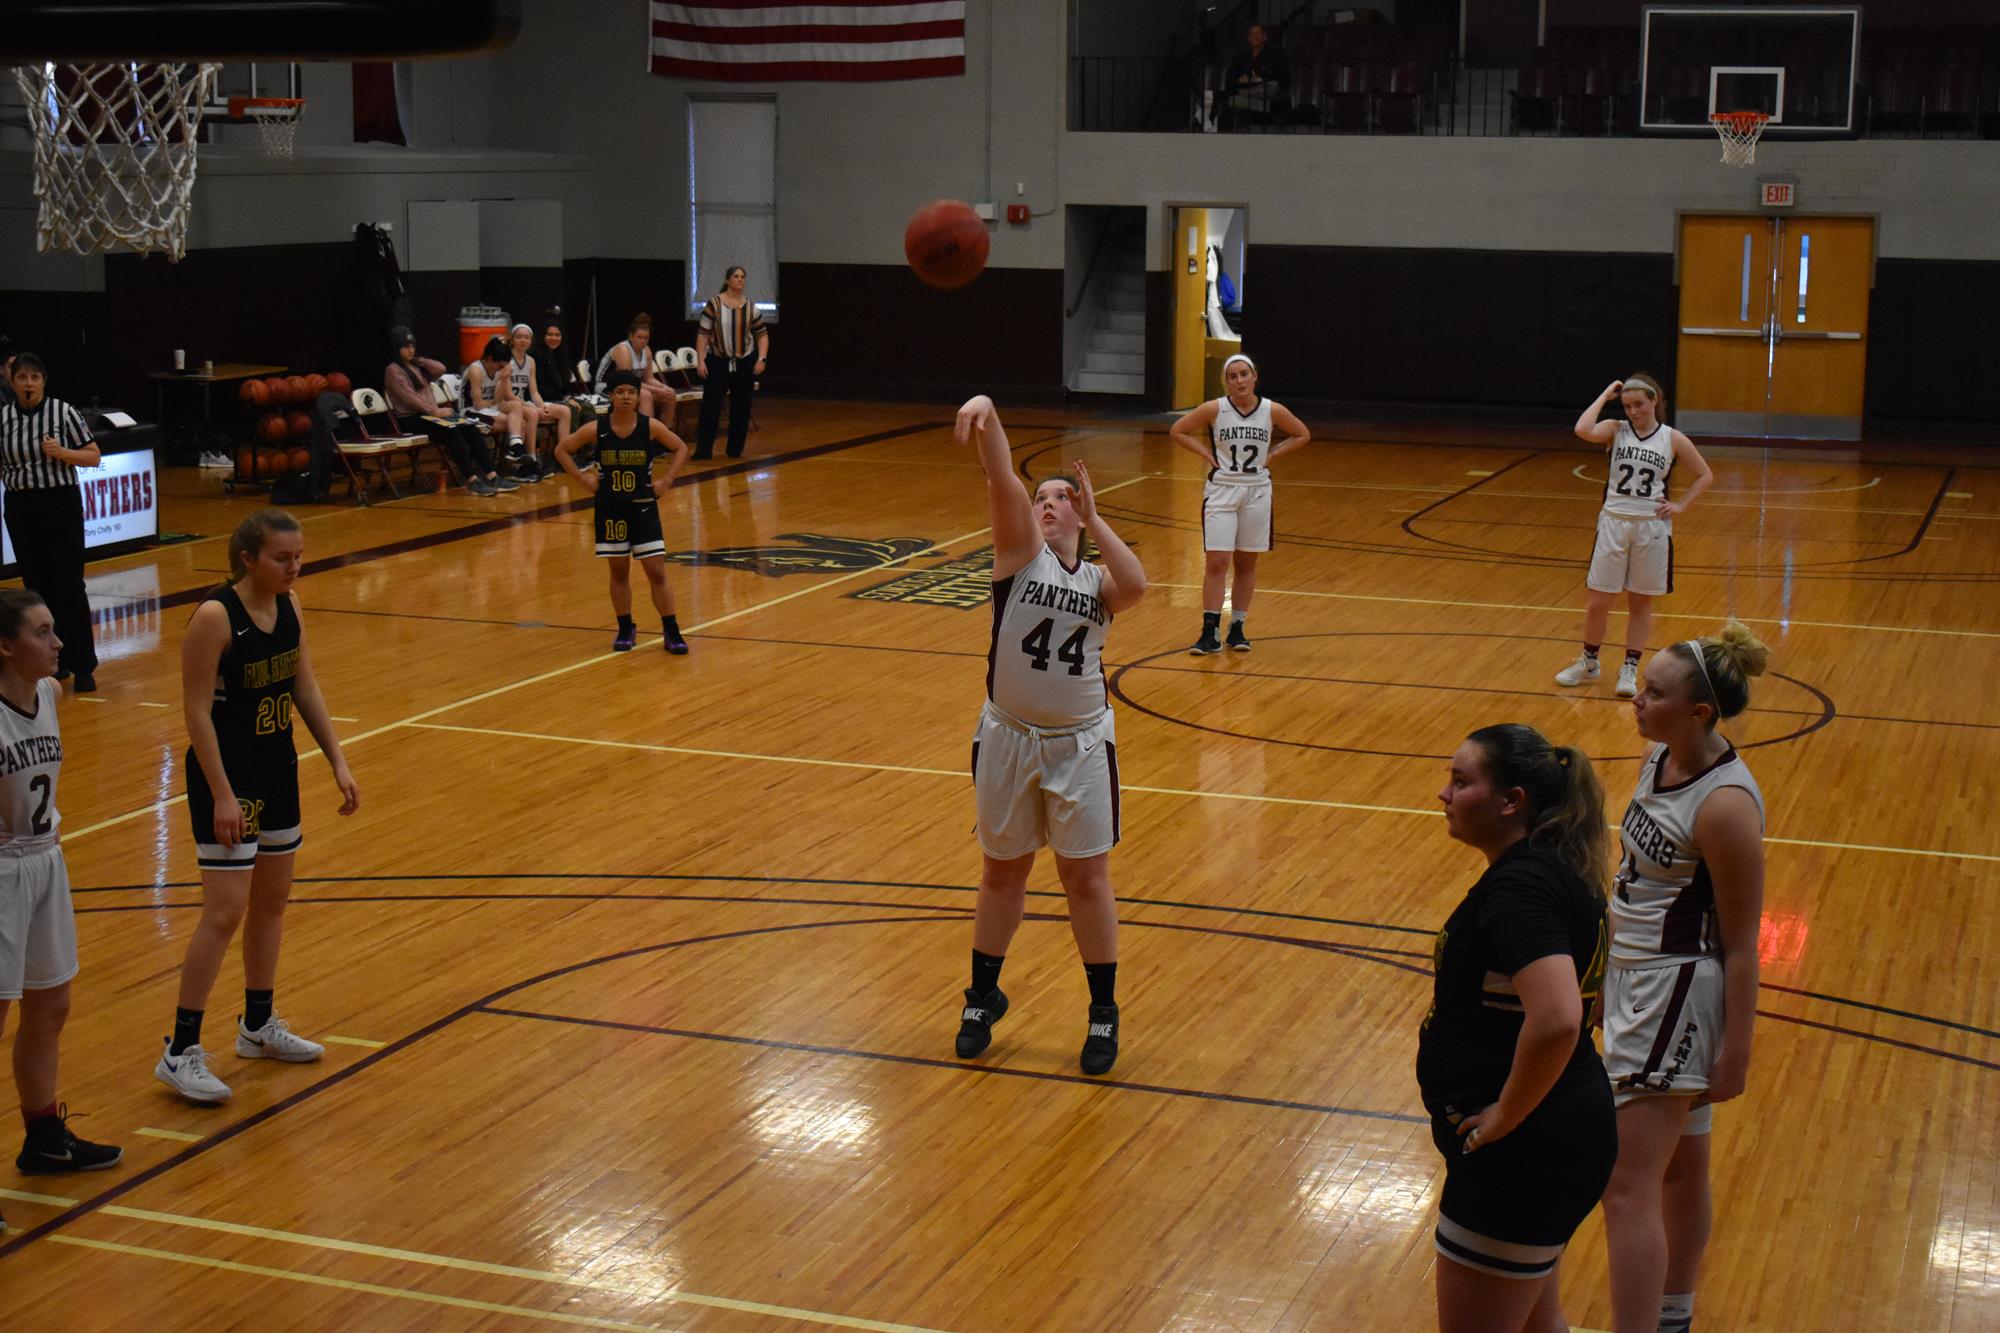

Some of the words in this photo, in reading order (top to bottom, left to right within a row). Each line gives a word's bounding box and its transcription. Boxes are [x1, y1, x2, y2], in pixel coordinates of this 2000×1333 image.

[1767, 185, 1790, 202] EXIT
[1219, 426, 1269, 443] PANTHERS
[1229, 444, 1258, 473] 12
[1615, 446, 1666, 470] PANTHERS
[612, 470, 636, 492] 10
[1616, 464, 1655, 497] 23
[604, 519, 628, 541] 10
[1020, 581, 1105, 627] PANTHERS
[1022, 618, 1090, 676] 44
[256, 692, 292, 736] 20
[30, 774, 52, 836] 2
[963, 1007, 985, 1021] NIKE
[1088, 1023, 1114, 1037] NIKE
